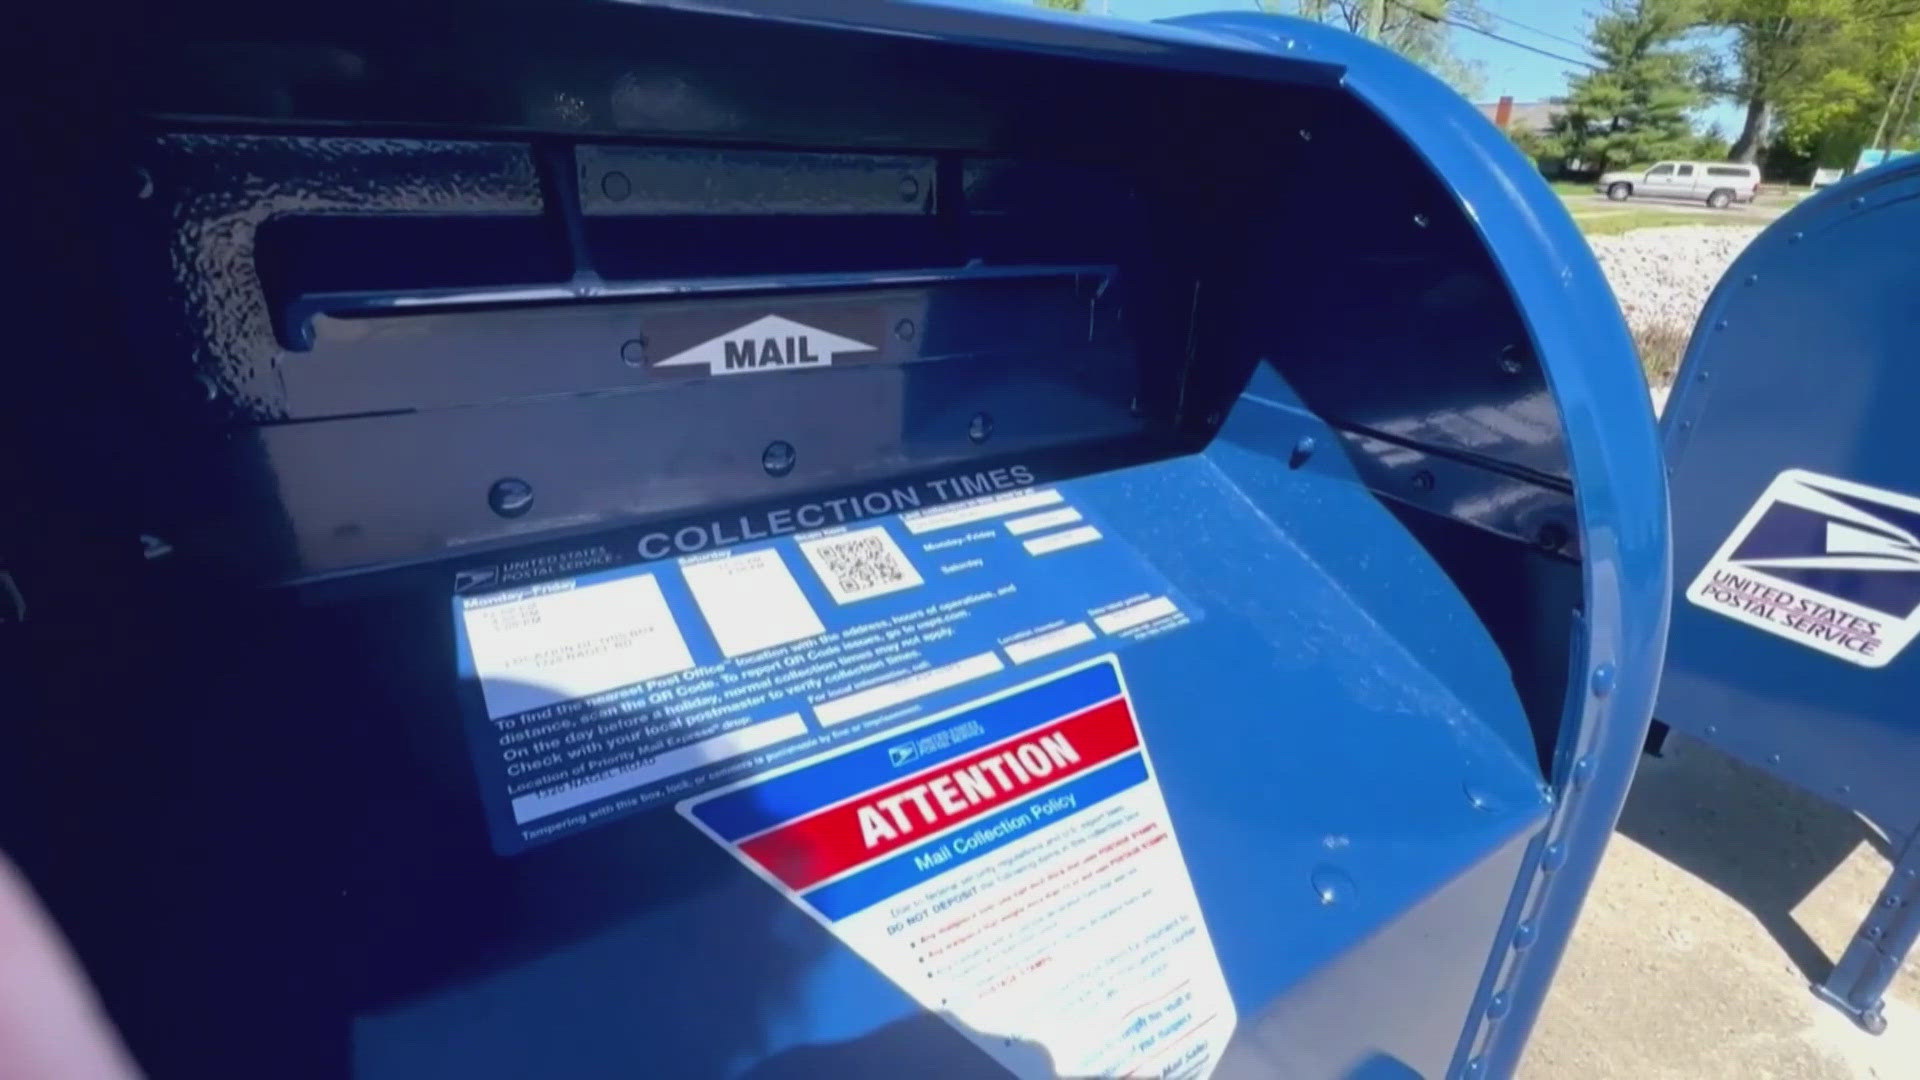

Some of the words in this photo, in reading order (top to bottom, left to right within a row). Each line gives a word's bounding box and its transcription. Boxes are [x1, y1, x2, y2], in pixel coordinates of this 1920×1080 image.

[724, 336, 819, 369] MAIL
[637, 485, 921, 559] COLLECTION
[926, 465, 1035, 502] TIMES
[503, 555, 558, 573] UNITED
[561, 547, 607, 563] STATES
[503, 566, 554, 583] POSTAL
[559, 555, 613, 572] SERVICE
[1700, 583, 1777, 623] POSTAL
[1779, 612, 1883, 658] SERVICE
[1711, 569, 1795, 607] UNITED
[1799, 597, 1882, 636] STATES
[496, 718, 515, 731] To
[520, 708, 552, 725] find
[557, 701, 582, 713] the
[586, 685, 643, 707] nearest
[647, 676, 679, 693] Post
[735, 647, 788, 665] location
[791, 638, 818, 652] with
[820, 633, 840, 645] the
[892, 609, 925, 624] hours
[926, 606, 938, 615] of
[997, 583, 1017, 596] and
[580, 708, 618, 723] scan
[620, 697, 646, 713] the
[650, 690, 674, 704] QR
[720, 673, 739, 684] To
[742, 660, 782, 679] report
[784, 654, 805, 666] QR
[807, 644, 841, 660] Code
[886, 628, 900, 640] go
[902, 624, 915, 634] to
[503, 747, 528, 761] On
[533, 738, 560, 754] the
[565, 729, 594, 745] day
[598, 715, 649, 735] before
[652, 709, 662, 719] a
[724, 678, 773, 699] normal
[775, 661, 836, 684] collection
[838, 649, 874, 667] times
[875, 643, 899, 656] may
[901, 636, 921, 648] not
[507, 752, 563, 777] Check
[567, 742, 603, 759] with
[606, 731, 641, 750] your
[645, 716, 683, 734] local
[685, 695, 766, 728] postmaster
[768, 688, 783, 699] to
[787, 675, 822, 694] verify
[824, 660, 884, 683] collection
[507, 769, 568, 795] Location
[572, 764, 586, 776] of
[588, 748, 635, 770] Priority
[638, 739, 665, 755] Mail
[857, 730, 1082, 850] ATTENTION
[522, 813, 587, 841] Tampering
[589, 804, 615, 819] with
[616, 795, 639, 810] this
[694, 774, 706, 785] or
[914, 845, 953, 871] Mail
[953, 813, 1032, 854] Collection
[1030, 793, 1077, 821] Policy
[886, 921, 904, 936] DO
[905, 908, 929, 926] NOT
[931, 886, 978, 914] DEPOSIT
